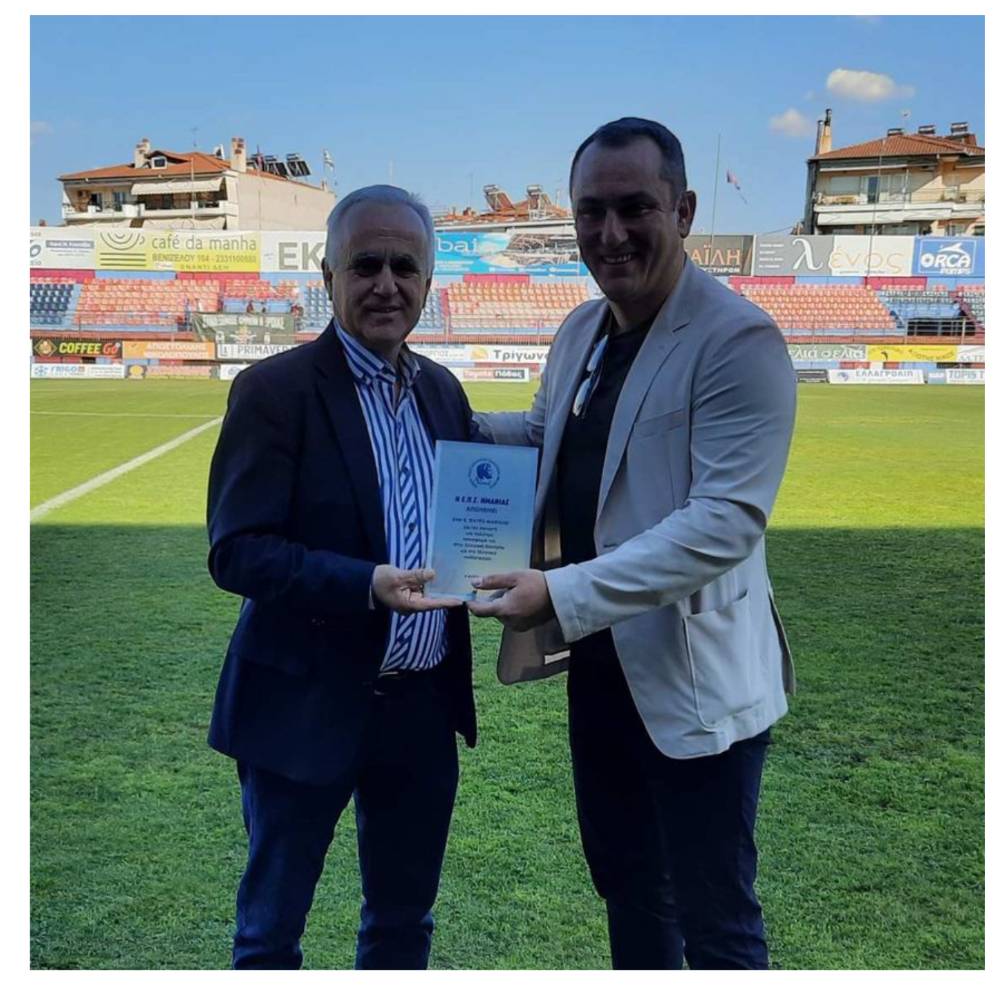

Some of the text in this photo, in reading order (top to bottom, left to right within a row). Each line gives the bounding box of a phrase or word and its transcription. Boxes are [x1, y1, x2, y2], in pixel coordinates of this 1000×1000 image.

[151, 233, 257, 251] café da manha
[920, 252, 971, 269] ORCA
[59, 342, 102, 354] COFFEE
